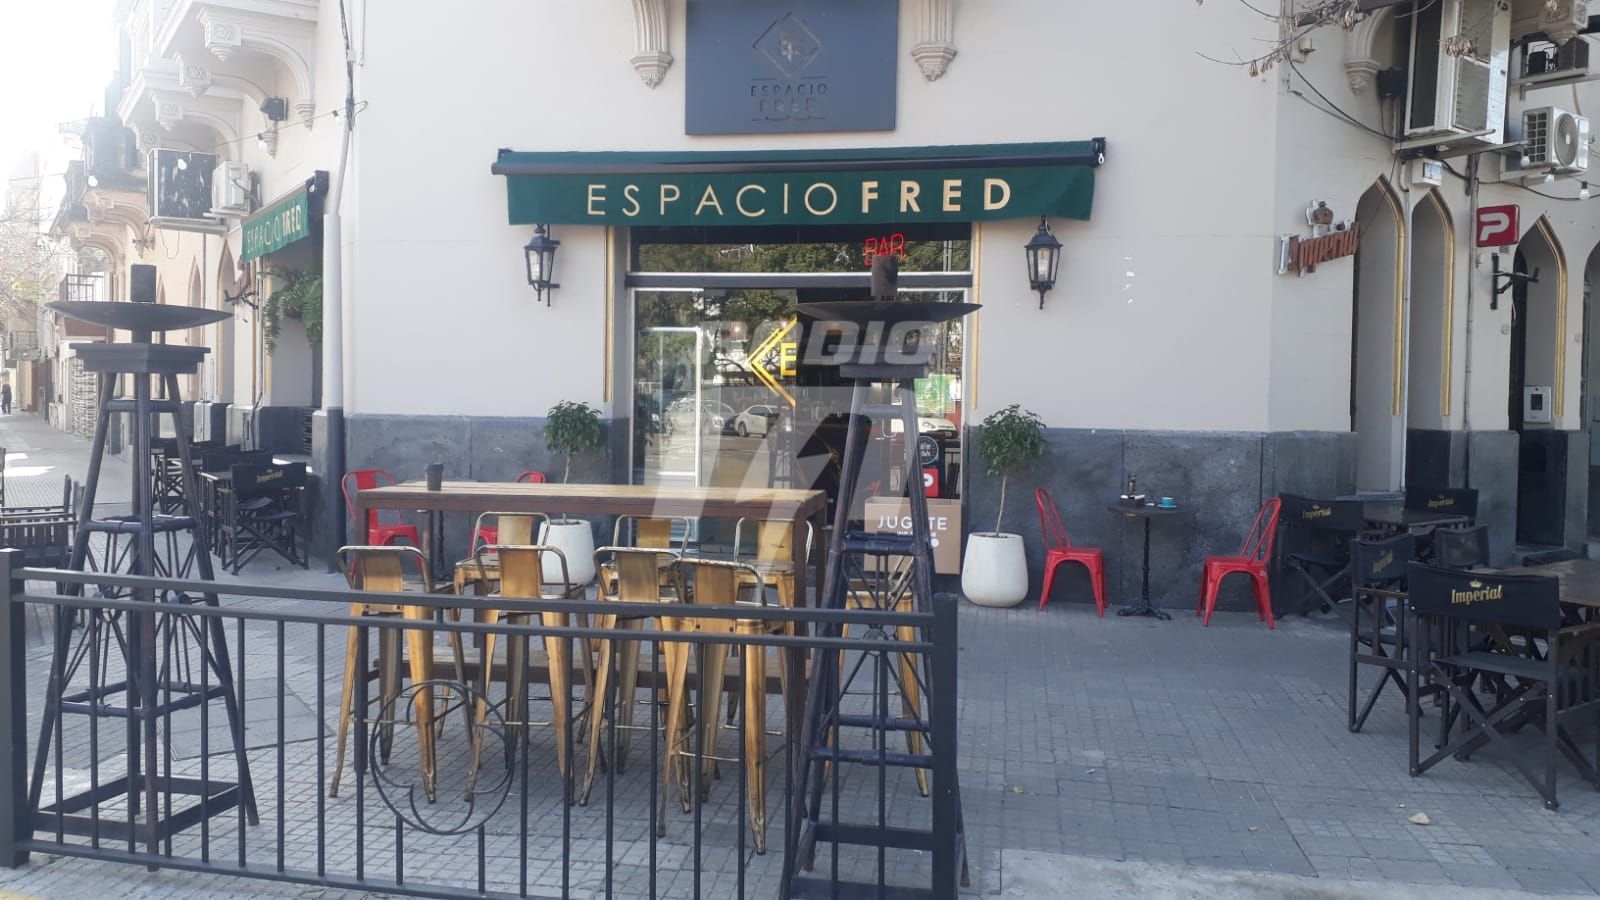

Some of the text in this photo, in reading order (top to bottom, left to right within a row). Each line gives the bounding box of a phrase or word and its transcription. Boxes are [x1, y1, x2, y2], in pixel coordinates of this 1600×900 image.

[750, 83, 828, 96] ESPACIO
[587, 177, 1011, 217] ESPACIO FRED
[247, 215, 280, 254] ESPACIO
[864, 233, 905, 267] BAR
[877, 515, 947, 530] JUGTE
[1451, 584, 1503, 605] Imperial
